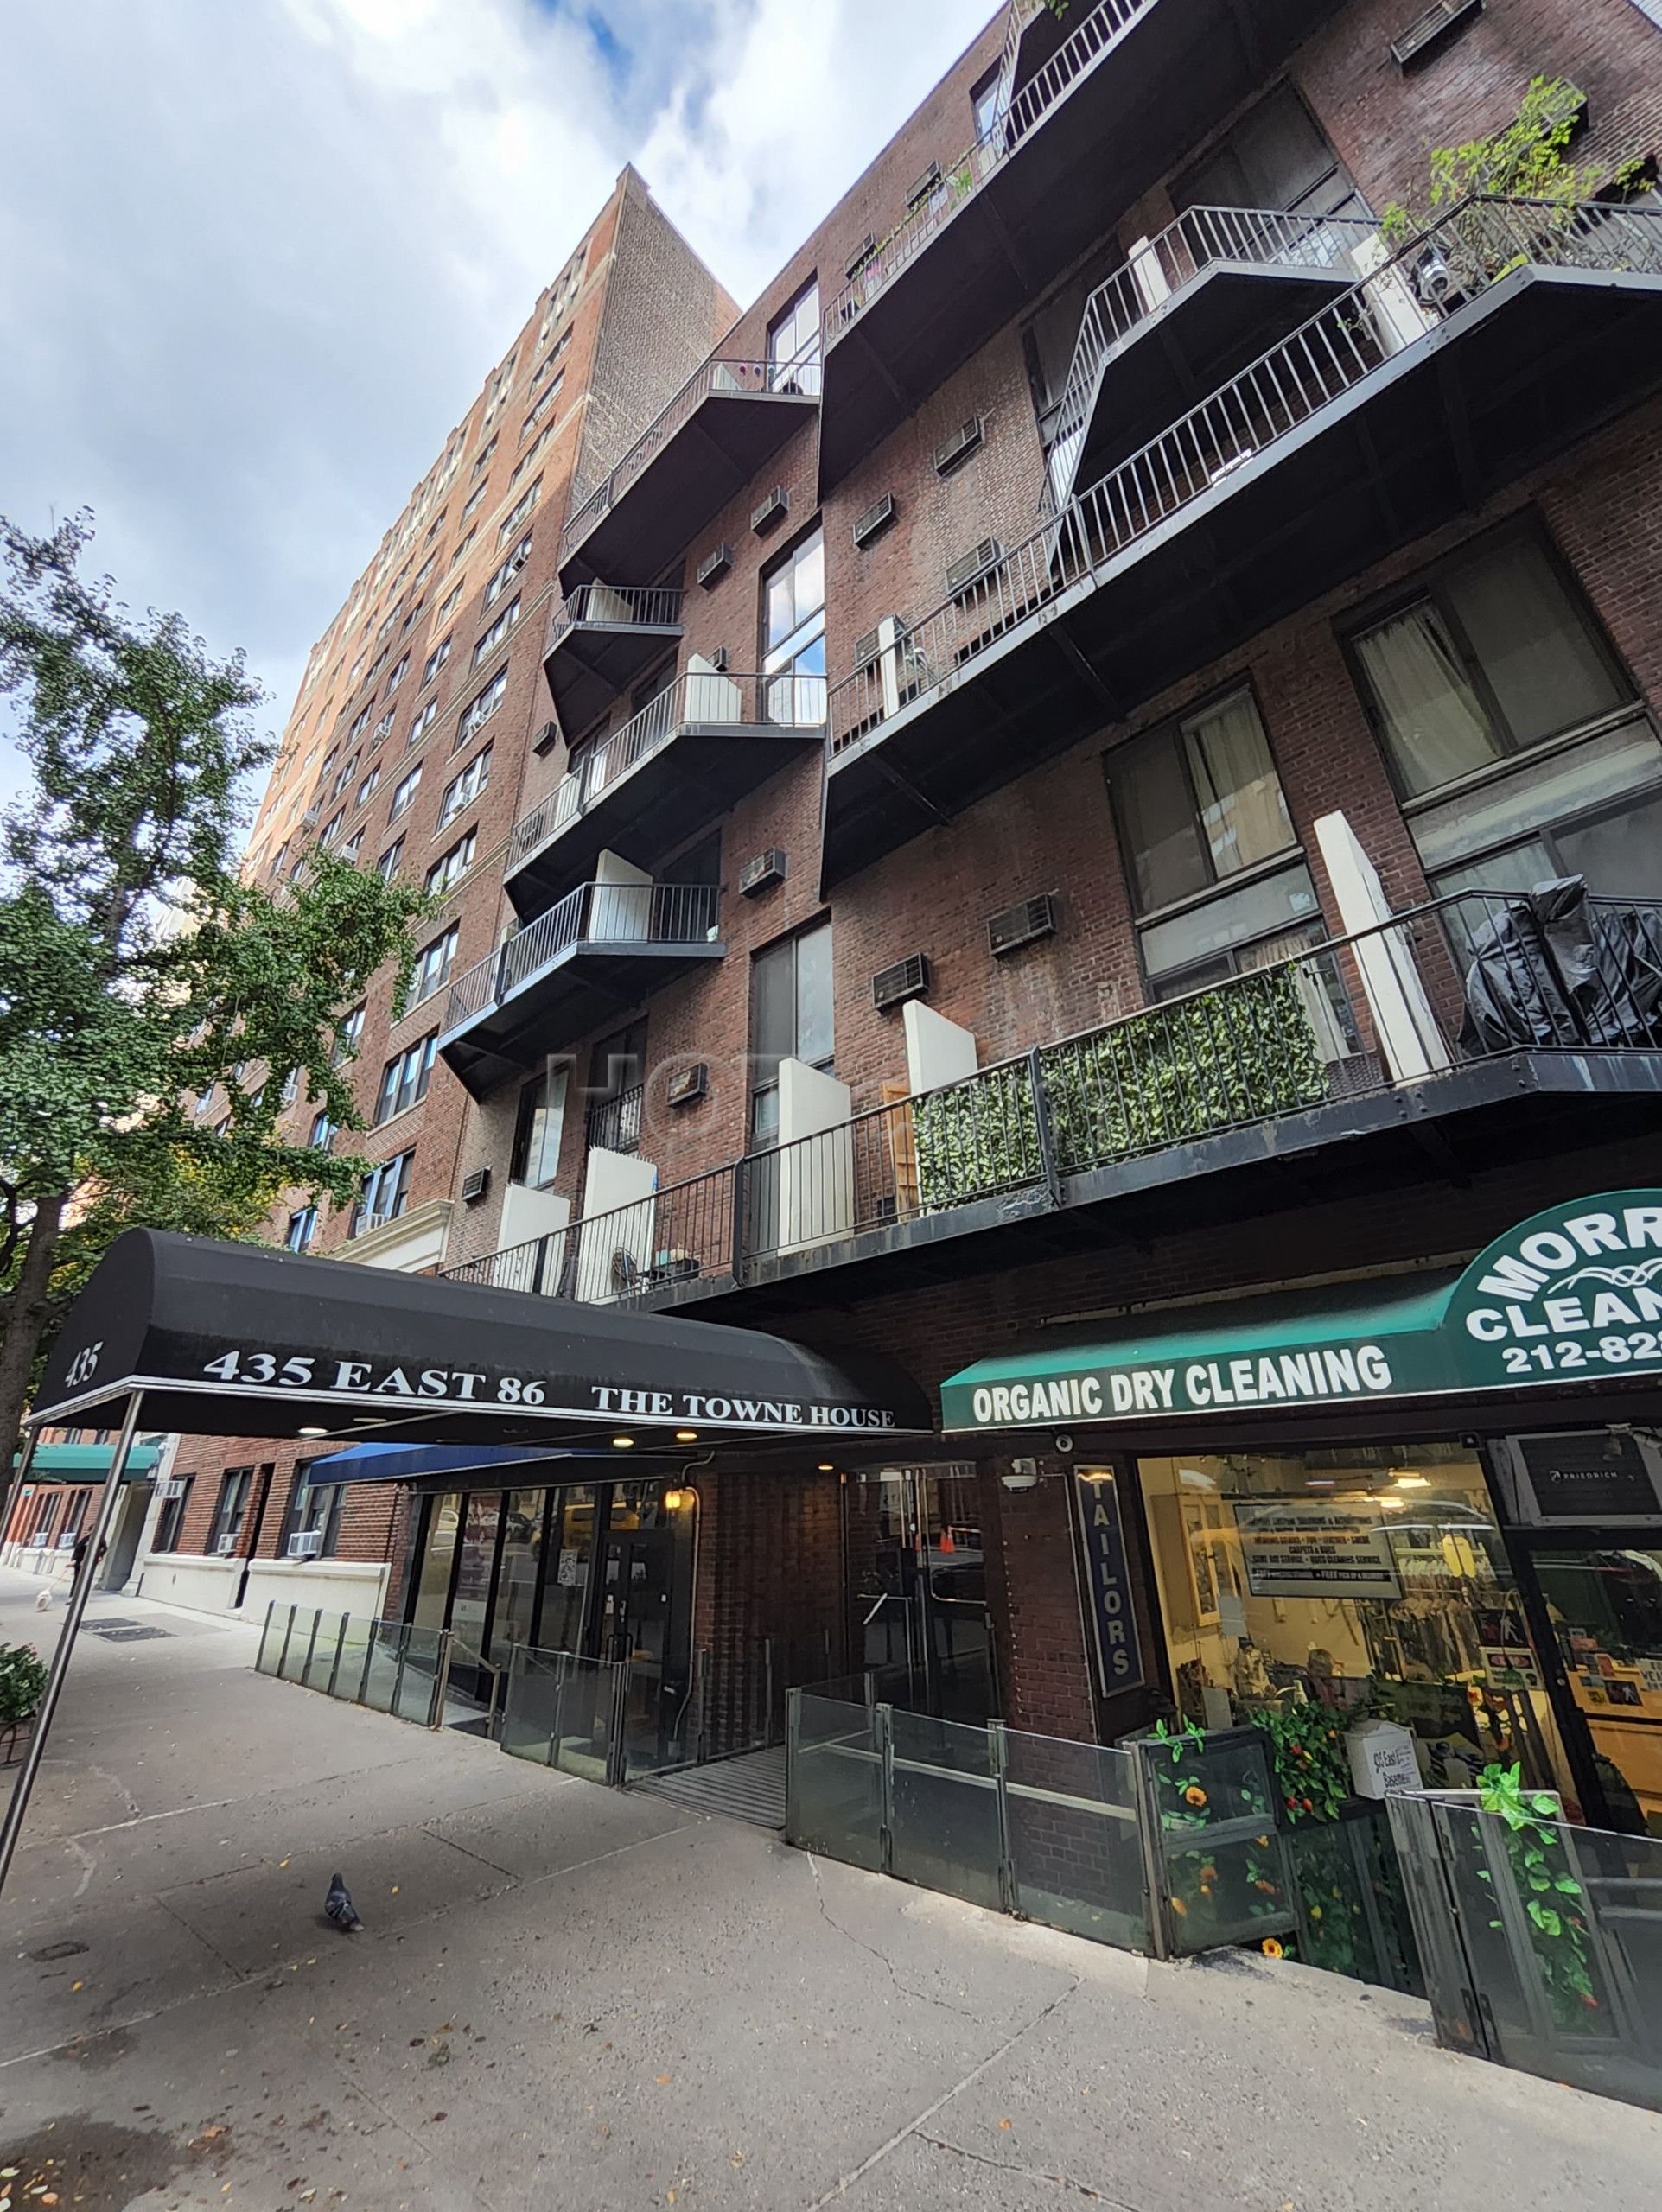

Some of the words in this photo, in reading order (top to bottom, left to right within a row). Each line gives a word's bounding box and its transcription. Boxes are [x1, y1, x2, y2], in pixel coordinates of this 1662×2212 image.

[64, 1340, 104, 1389] 435
[203, 1350, 315, 1386] 435
[334, 1360, 486, 1400] EAST
[498, 1377, 546, 1406] 86
[591, 1385, 673, 1415] THE
[682, 1394, 802, 1425] TOWNE
[809, 1405, 895, 1427] HOUSE
[973, 1376, 1104, 1423] ORGANIC
[1111, 1367, 1174, 1414] DRY
[1185, 1344, 1392, 1404] CLEANING
[1502, 1332, 1662, 1374] 212-82
[1091, 1480, 1130, 1676] TAILORS
